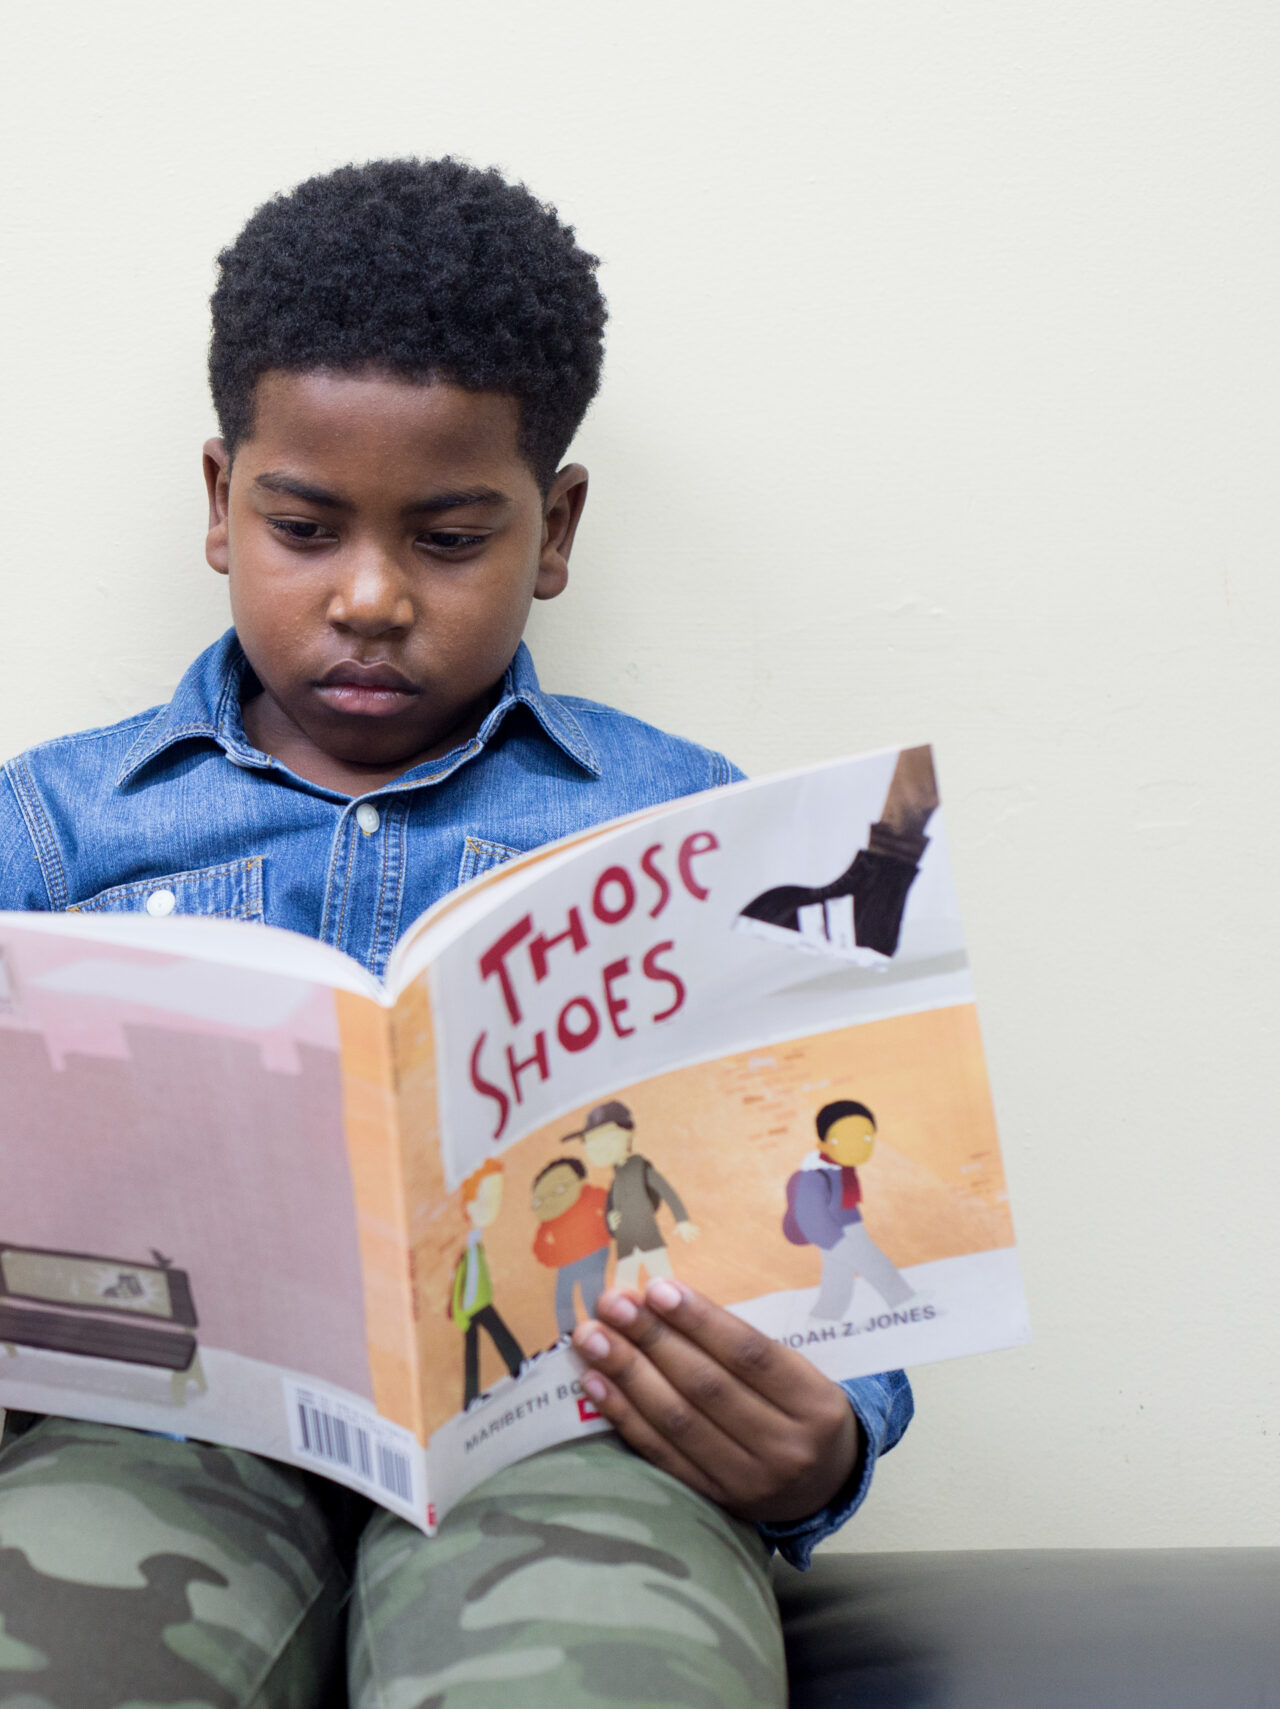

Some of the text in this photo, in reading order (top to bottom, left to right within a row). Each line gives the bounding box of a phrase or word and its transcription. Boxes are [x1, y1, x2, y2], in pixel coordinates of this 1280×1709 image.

[479, 831, 720, 1028] THOSE
[470, 939, 687, 1141] SHOES
[864, 1305, 937, 1333] JONES
[464, 1392, 550, 1453] MARIBETH
[556, 1379, 585, 1401] BO
